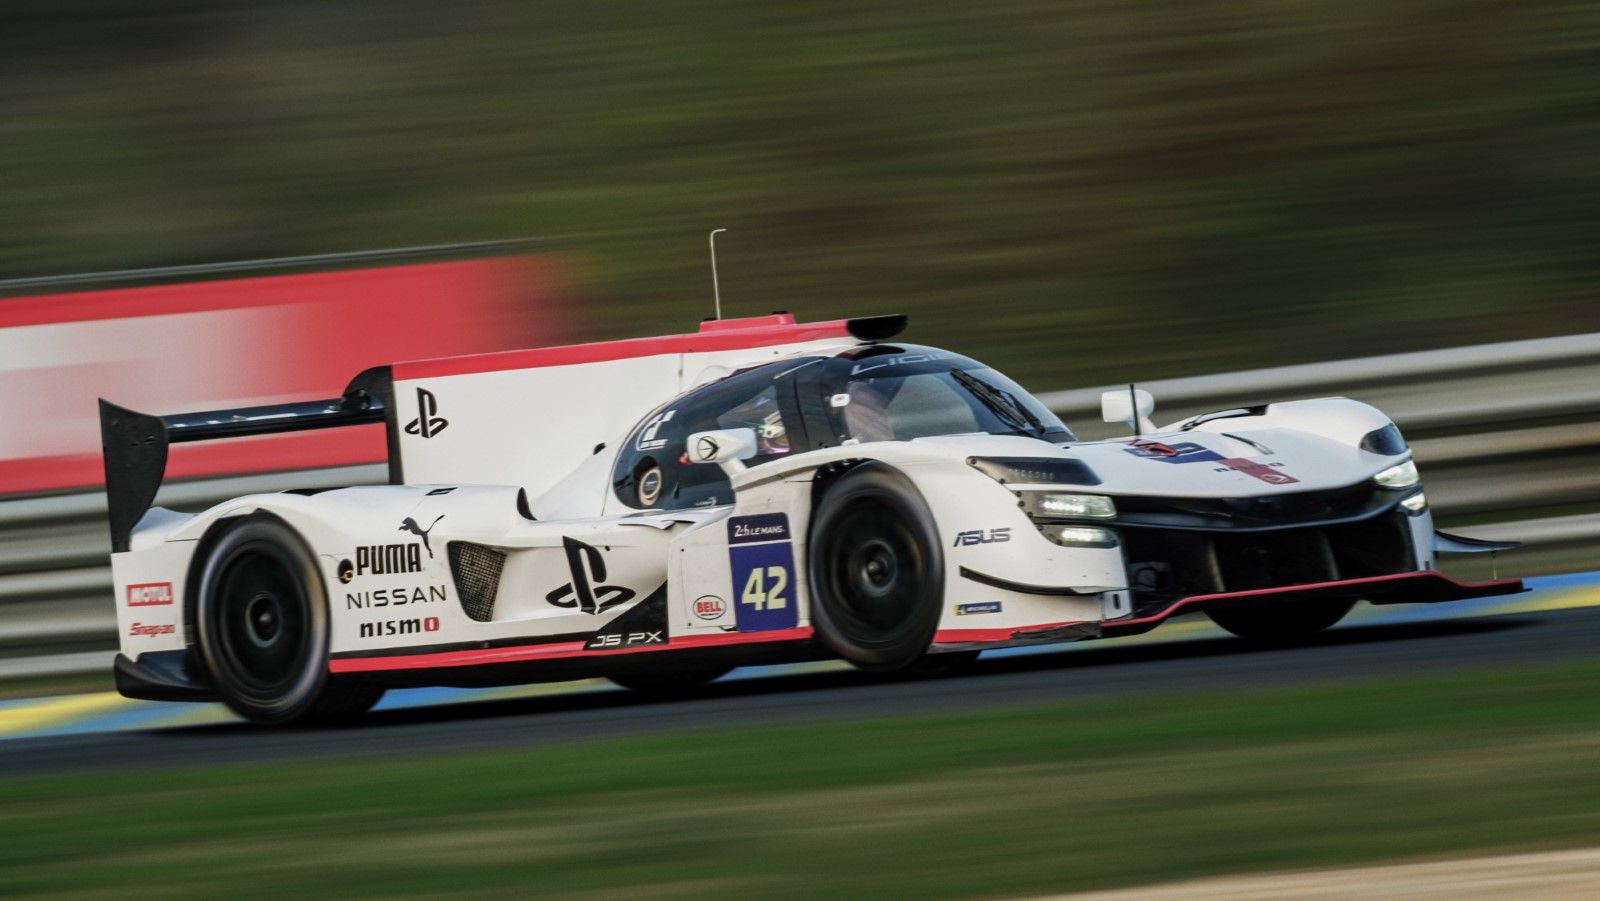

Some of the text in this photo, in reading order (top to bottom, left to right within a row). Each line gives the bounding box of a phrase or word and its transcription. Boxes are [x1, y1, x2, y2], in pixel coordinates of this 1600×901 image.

[750, 527, 760, 536] LE
[760, 525, 784, 535] MANS
[953, 527, 1011, 548] ASUS
[355, 543, 422, 576] PUMA
[347, 585, 447, 610] NISSAN
[741, 566, 788, 611] 42
[697, 601, 721, 613] BELL
[626, 630, 663, 646] PX
